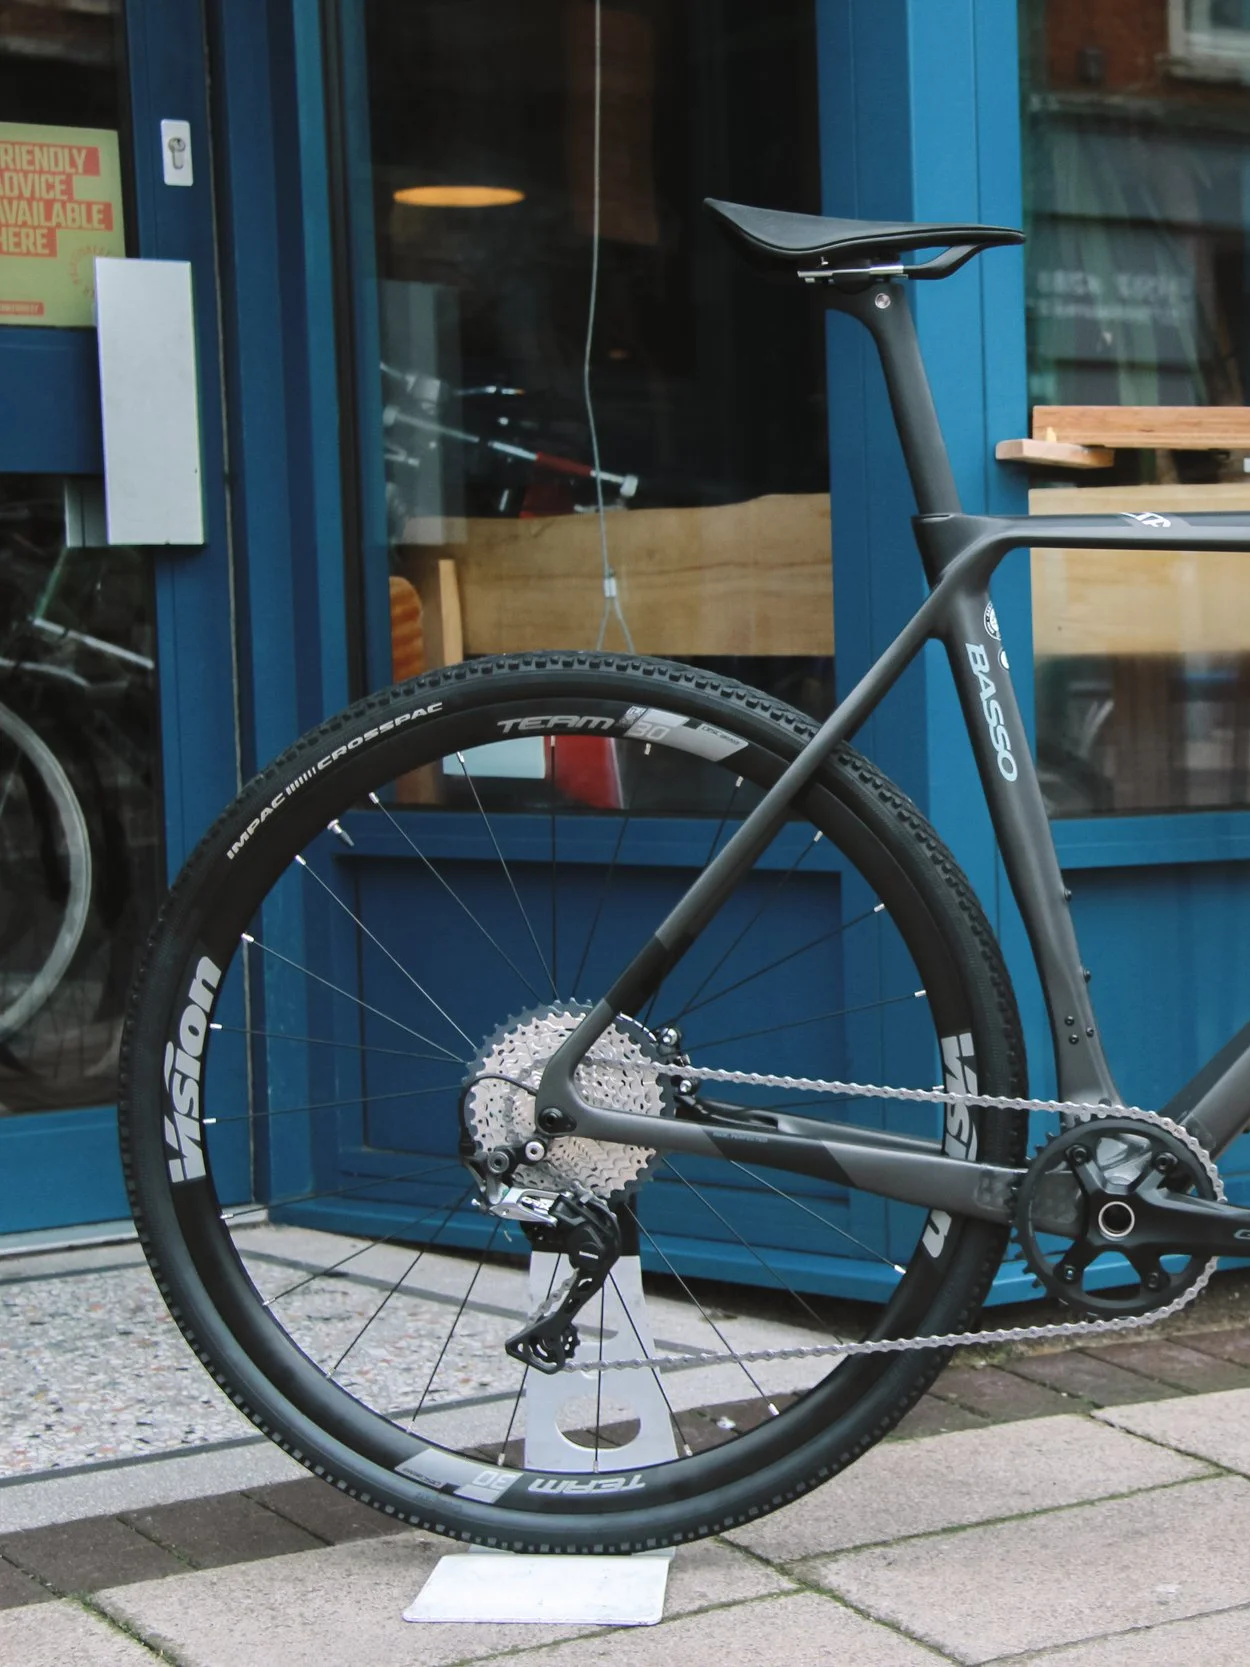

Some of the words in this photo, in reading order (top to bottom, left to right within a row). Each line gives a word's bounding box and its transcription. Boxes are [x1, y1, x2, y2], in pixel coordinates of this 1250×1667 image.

[0, 143, 87, 174] RIENDLY
[0, 171, 68, 200] DVICE
[965, 642, 1018, 782] BASSO
[628, 720, 671, 740] 30
[226, 793, 286, 860] IMPAC
[317, 702, 443, 771] CROSSPAC
